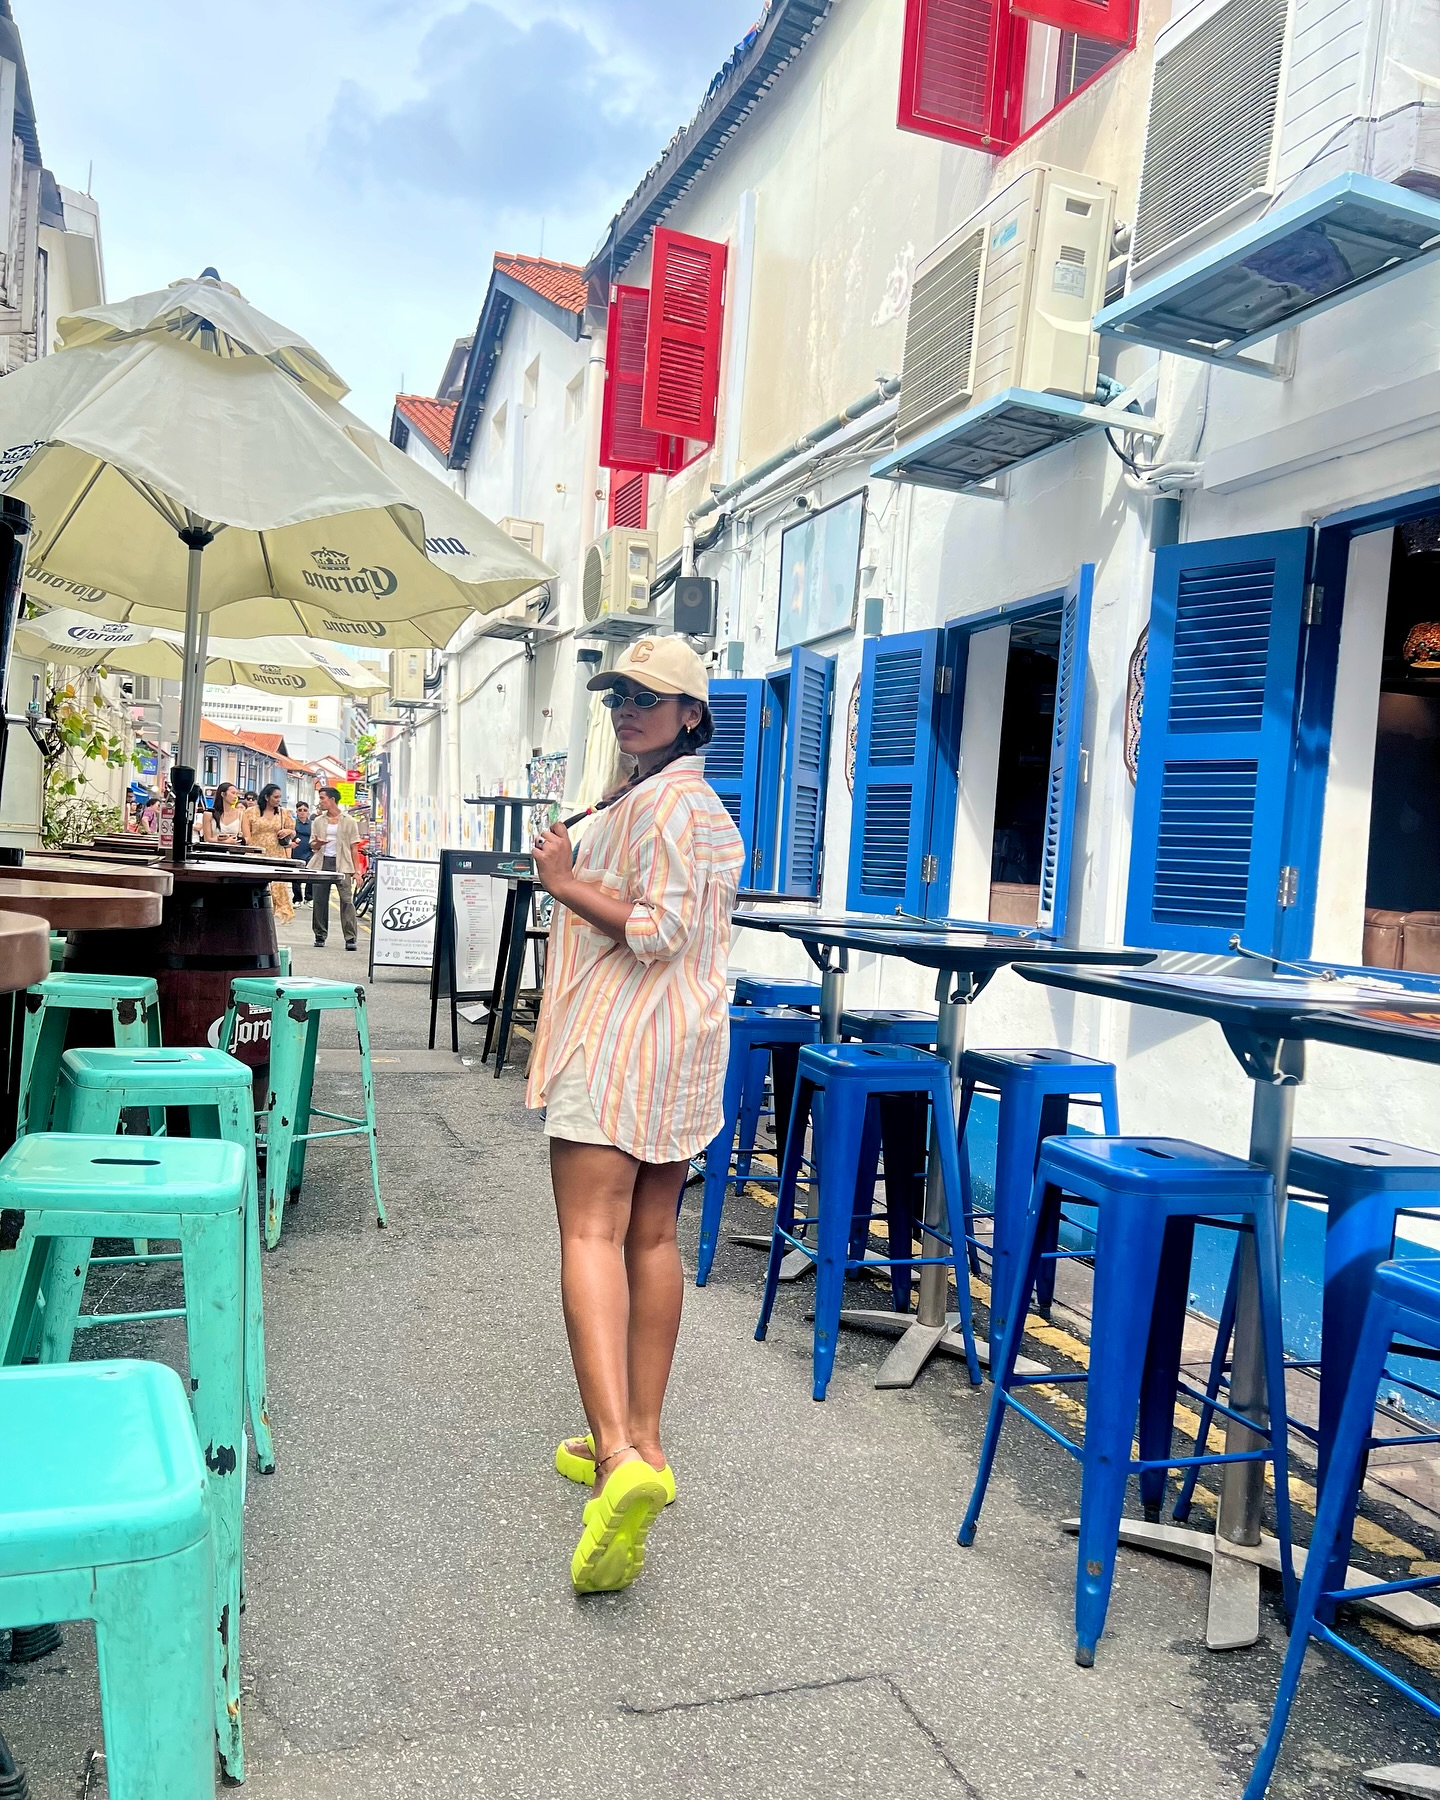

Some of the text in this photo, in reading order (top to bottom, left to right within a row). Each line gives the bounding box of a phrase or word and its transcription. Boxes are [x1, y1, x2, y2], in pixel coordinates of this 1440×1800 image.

[67, 626, 134, 641] Corona
[630, 641, 654, 663] C
[207, 1013, 272, 1054] Coro
